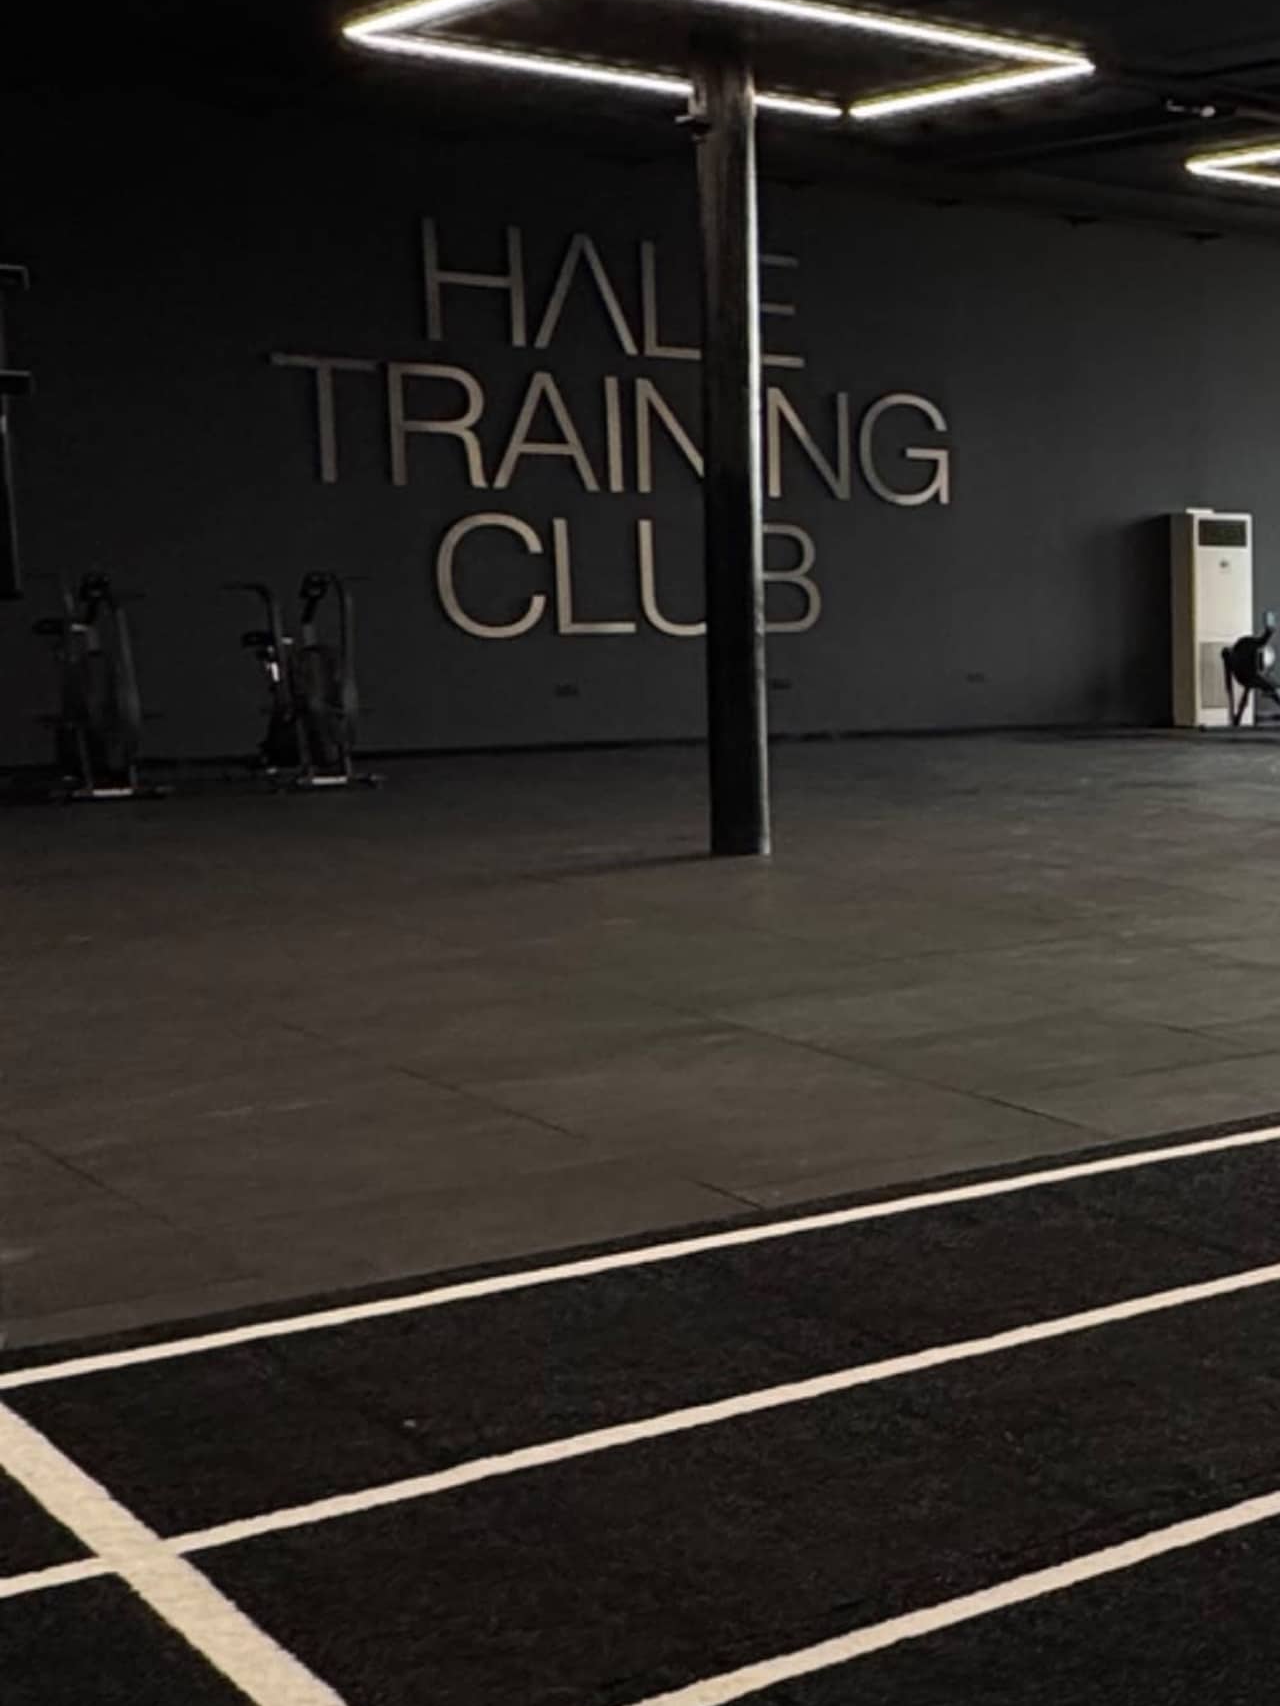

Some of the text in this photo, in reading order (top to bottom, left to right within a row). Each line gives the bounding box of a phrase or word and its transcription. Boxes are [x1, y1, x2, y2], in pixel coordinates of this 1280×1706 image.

[422, 215, 805, 369] HALE
[269, 352, 951, 506] TRAINING
[436, 511, 822, 639] CLUB
